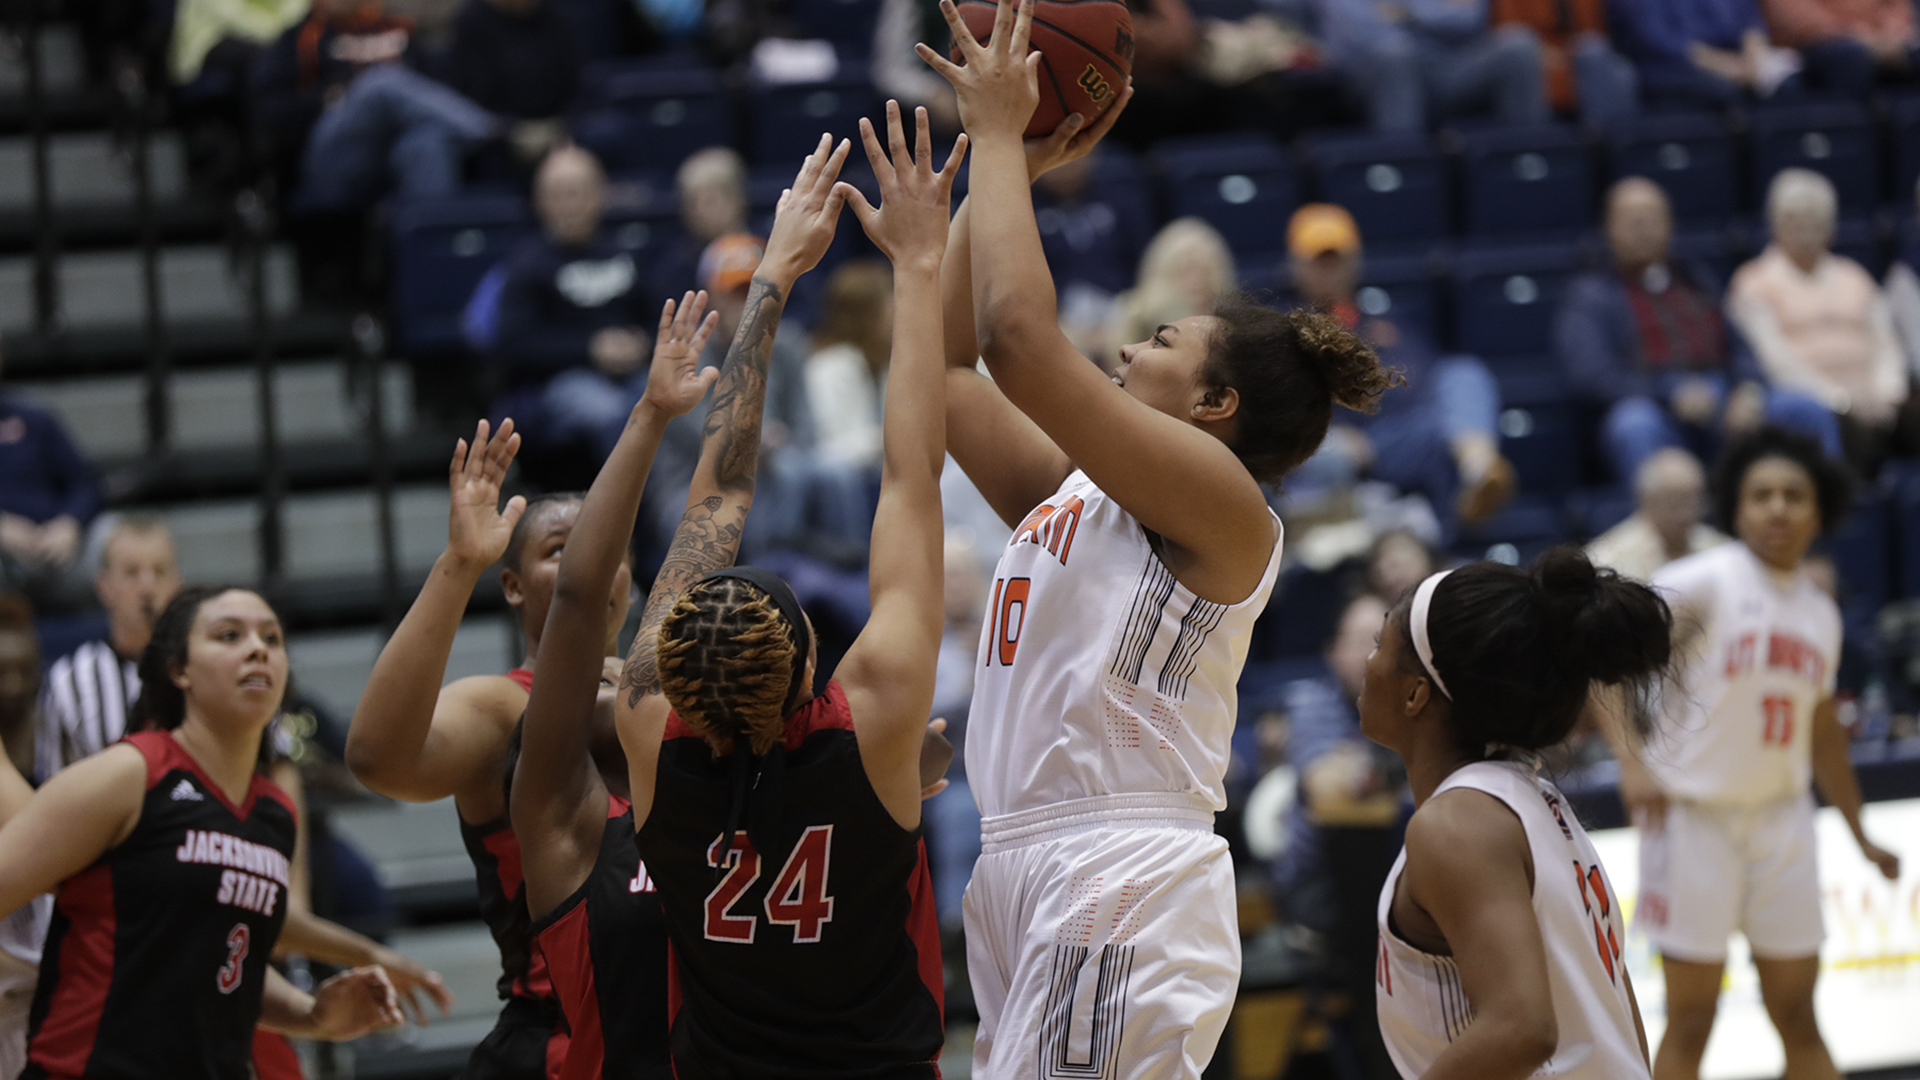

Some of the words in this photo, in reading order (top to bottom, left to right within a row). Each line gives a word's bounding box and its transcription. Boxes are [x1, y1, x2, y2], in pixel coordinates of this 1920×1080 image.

[985, 576, 1031, 667] 10
[175, 828, 290, 889] JACKSONVILL
[216, 867, 280, 918] STATE
[703, 823, 835, 944] 24
[215, 922, 250, 995] 3
